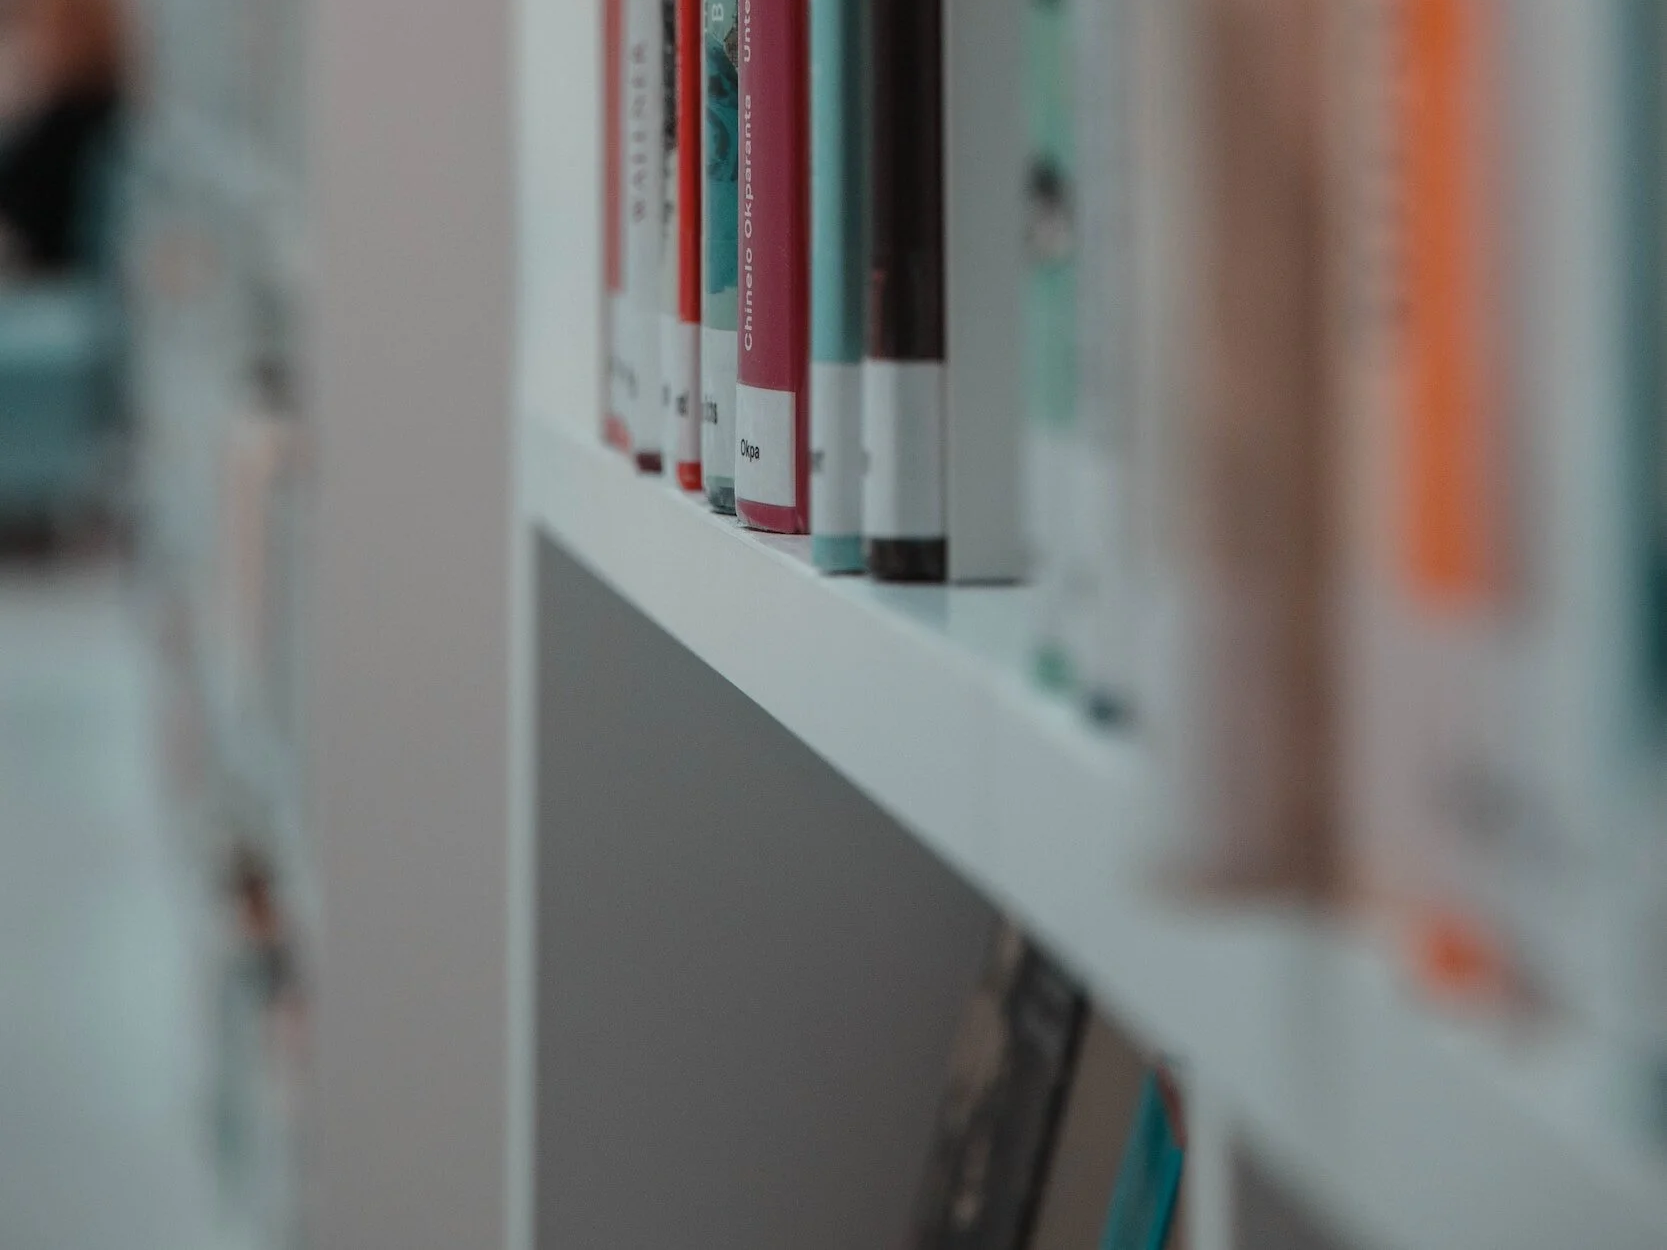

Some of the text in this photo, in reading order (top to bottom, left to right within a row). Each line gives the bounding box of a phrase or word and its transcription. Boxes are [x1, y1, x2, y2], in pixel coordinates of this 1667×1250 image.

[744, 94, 756, 352] Chinelo Okparanta
[740, 438, 760, 463] Okpa
